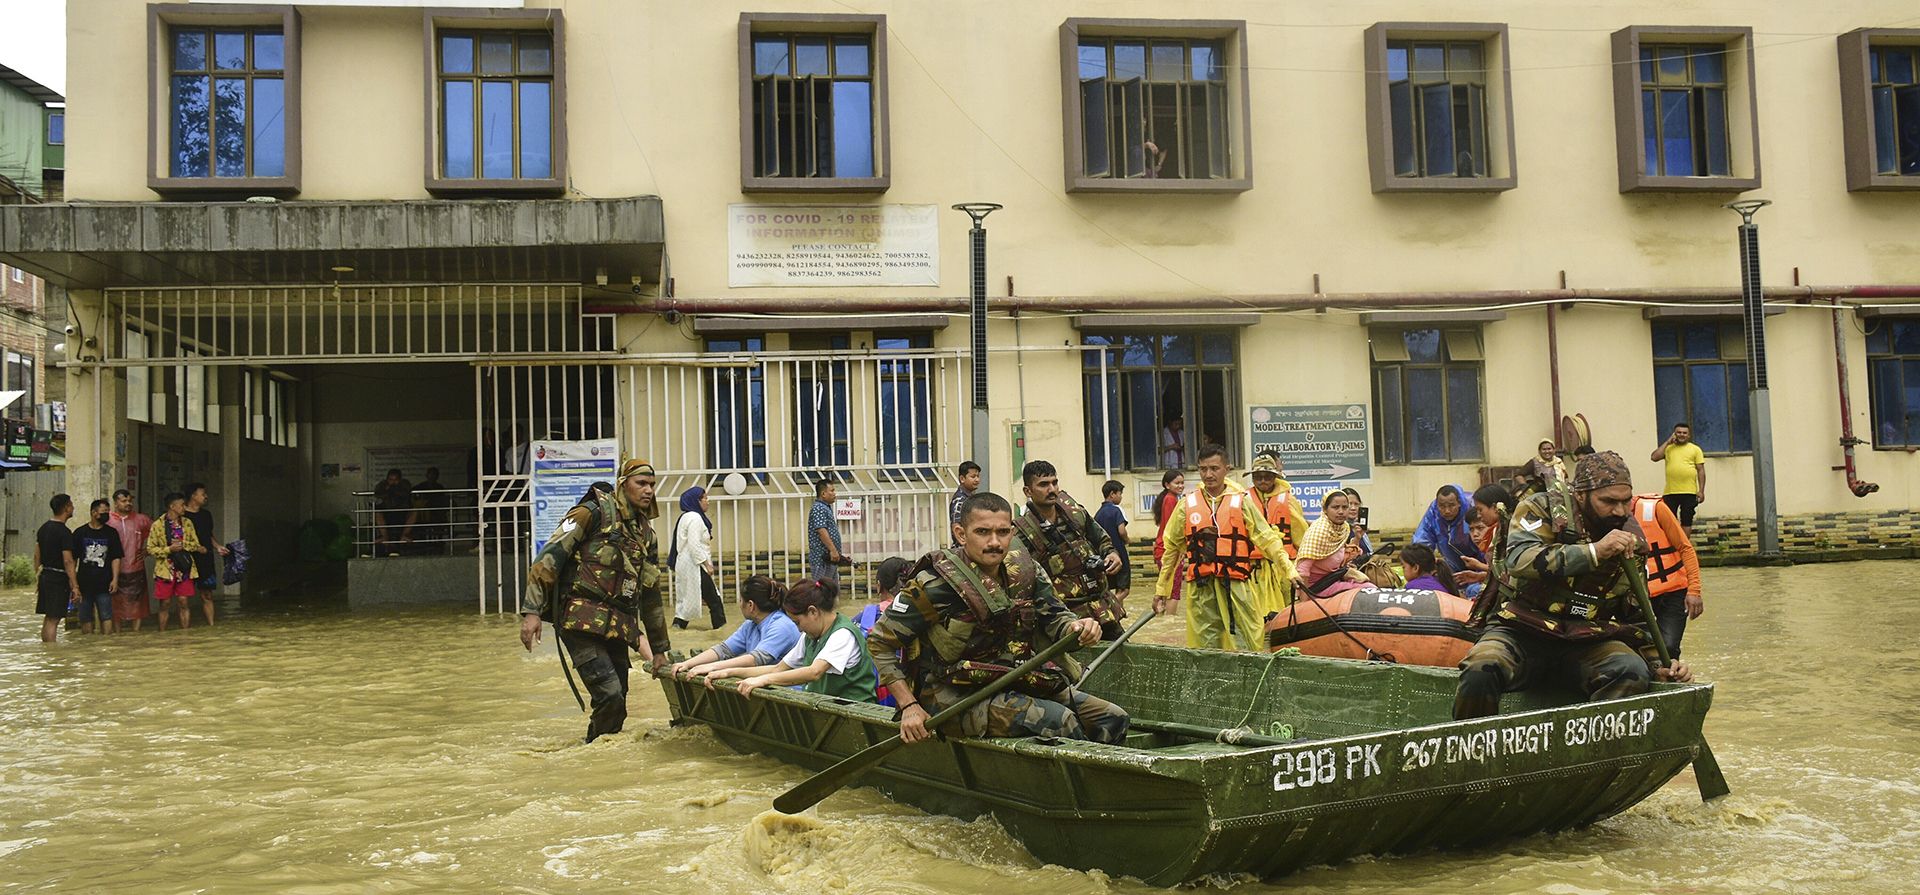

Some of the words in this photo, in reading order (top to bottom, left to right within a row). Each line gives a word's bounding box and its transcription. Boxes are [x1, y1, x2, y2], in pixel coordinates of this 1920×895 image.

[736, 214, 767, 224] FOR
[773, 214, 821, 224] COVID
[837, 214, 854, 224] 19
[746, 228, 855, 238] INFORMATION
[1255, 423, 1283, 432] MODEL
[1285, 421, 1332, 431] TREATMENT
[1334, 420, 1364, 430] CENTRE
[1255, 443, 1281, 452] STATE
[1282, 442, 1339, 452] LABORATORY,
[1341, 441, 1365, 451] JNIMS
[1378, 593, 1415, 604] E-14
[1272, 747, 1336, 791] 298
[1346, 743, 1382, 780] PK
[1401, 738, 1442, 772] 267
[1446, 729, 1498, 764] ENGR
[1501, 722, 1554, 756] REGT
